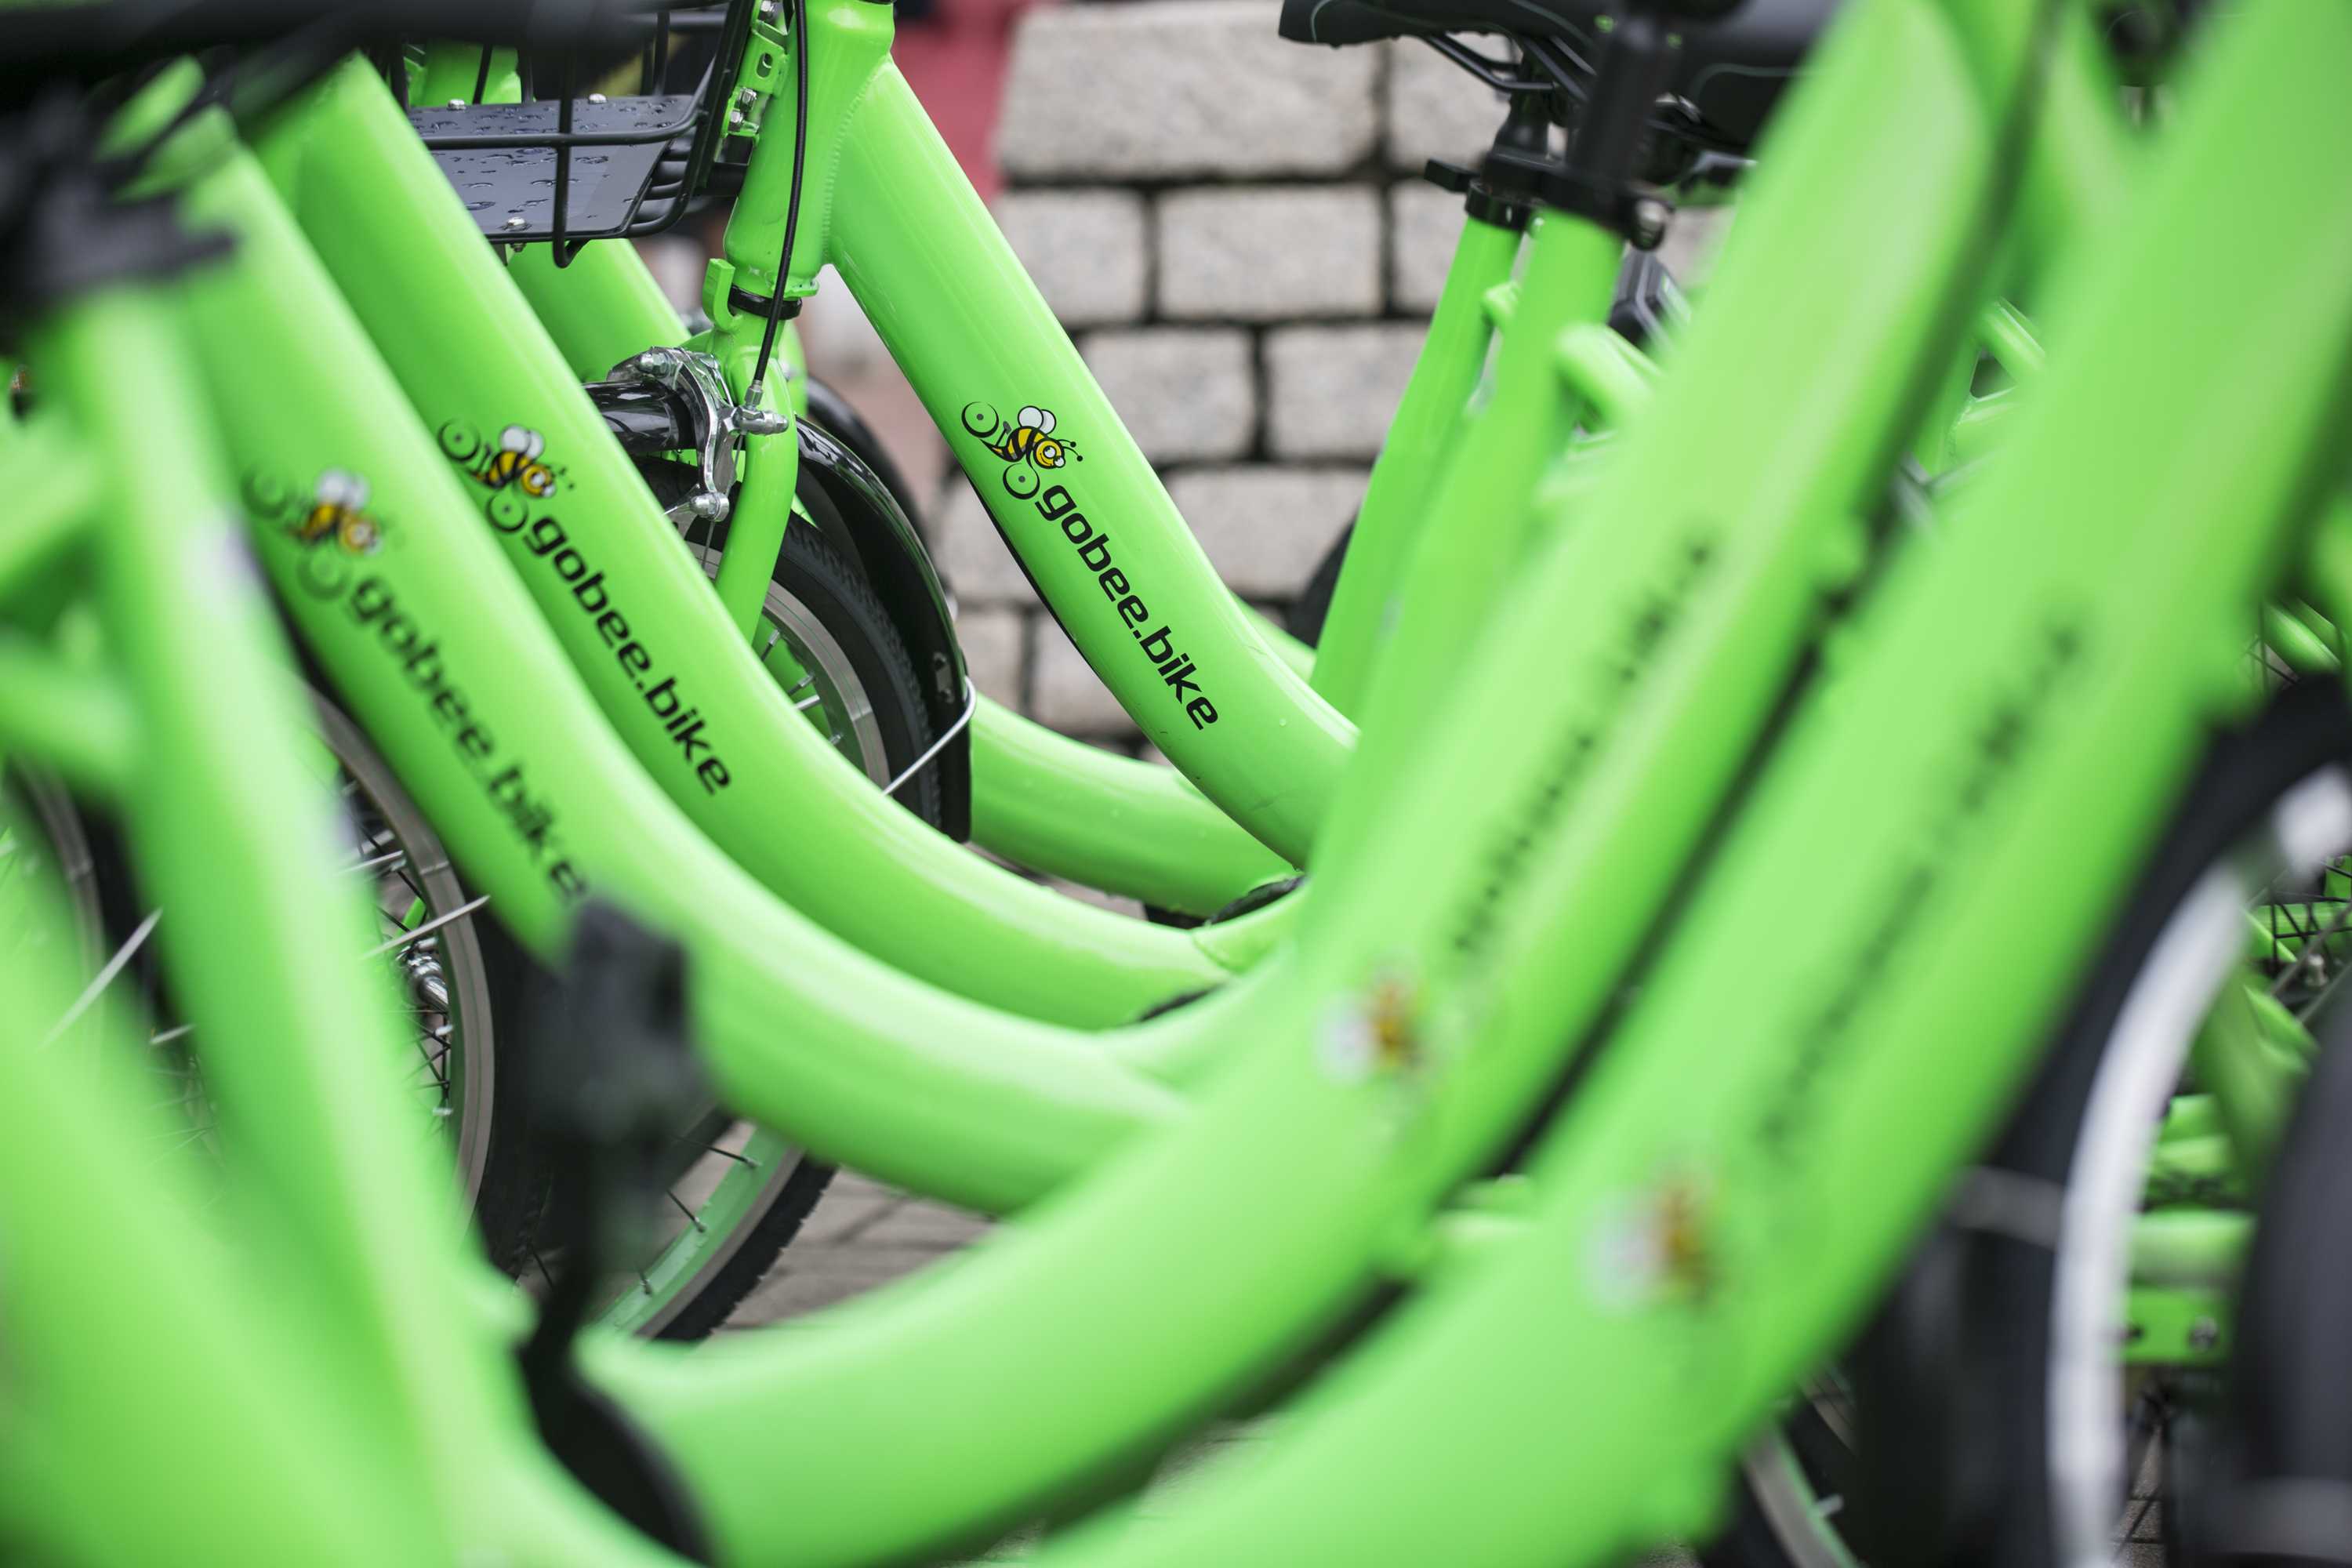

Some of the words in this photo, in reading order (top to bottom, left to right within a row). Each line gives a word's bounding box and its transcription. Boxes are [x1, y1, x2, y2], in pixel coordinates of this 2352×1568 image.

[348, 575, 587, 898] gobeebike
[524, 516, 730, 795] gobee.bike
[1035, 485, 1218, 731] gobee.bike
